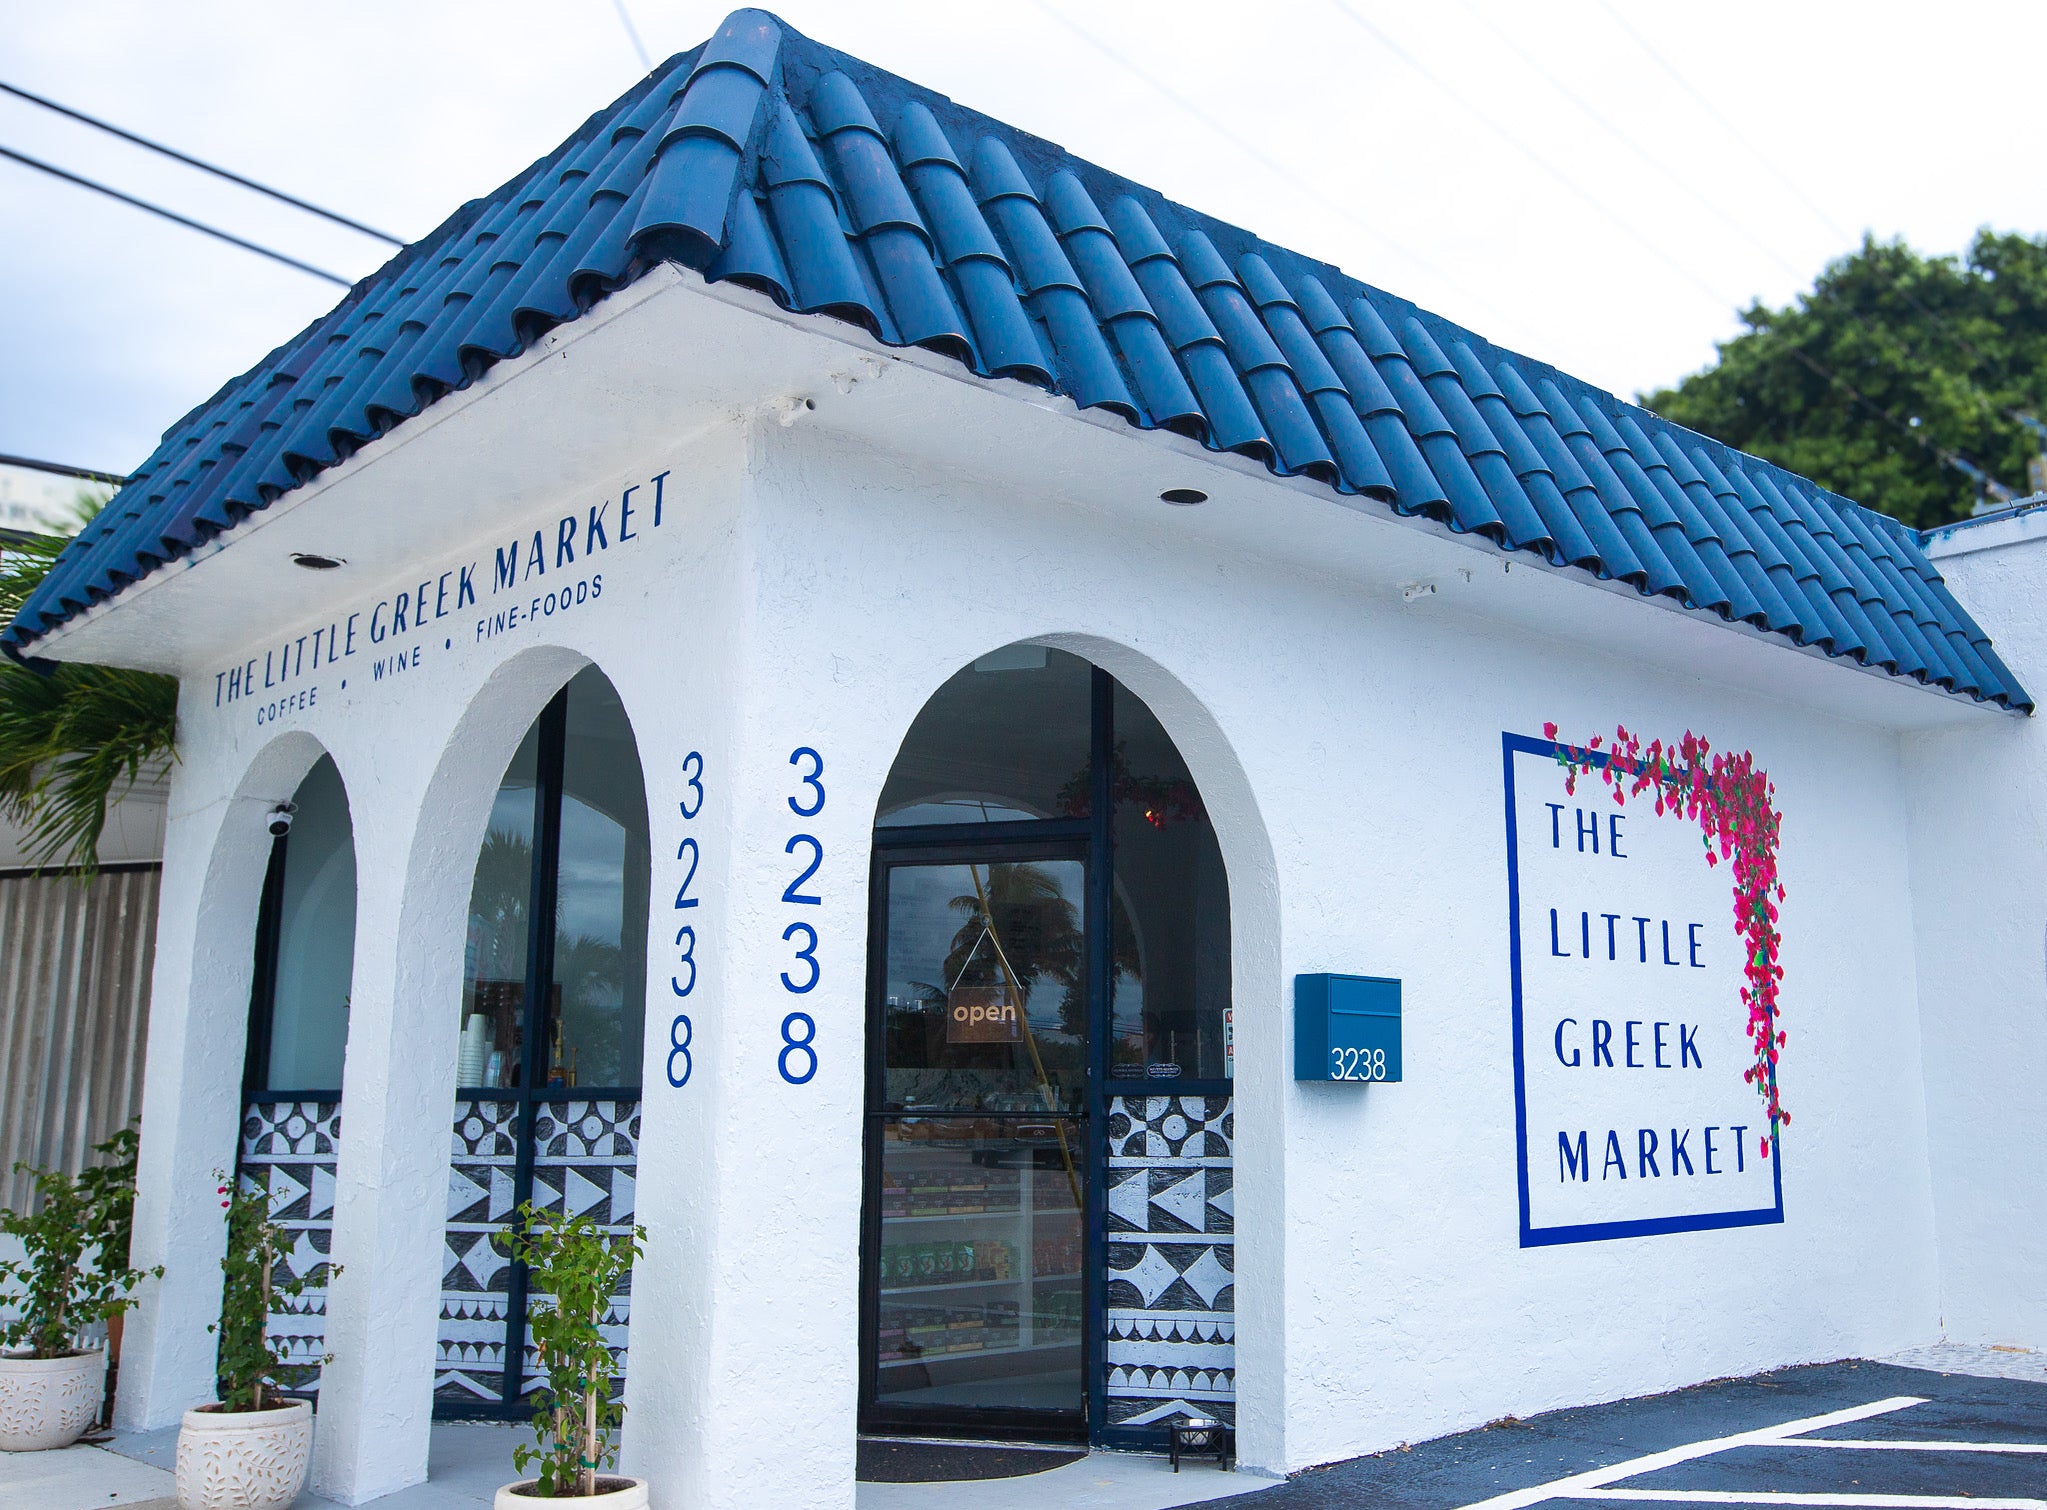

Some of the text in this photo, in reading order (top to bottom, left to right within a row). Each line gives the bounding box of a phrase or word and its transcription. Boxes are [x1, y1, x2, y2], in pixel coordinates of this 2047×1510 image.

[215, 470, 671, 707] THE LITTLE GREEK MARKET
[257, 574, 602, 726] COFFEE WINE FINE-FOODS
[1545, 802, 1628, 859] THE
[1550, 908, 1707, 968] LITTLE
[953, 1005, 1016, 1027] open
[1554, 1018, 1704, 1069] GREEK
[1331, 1047, 1386, 1081] 3238
[1558, 1126, 1749, 1184] MARKET
